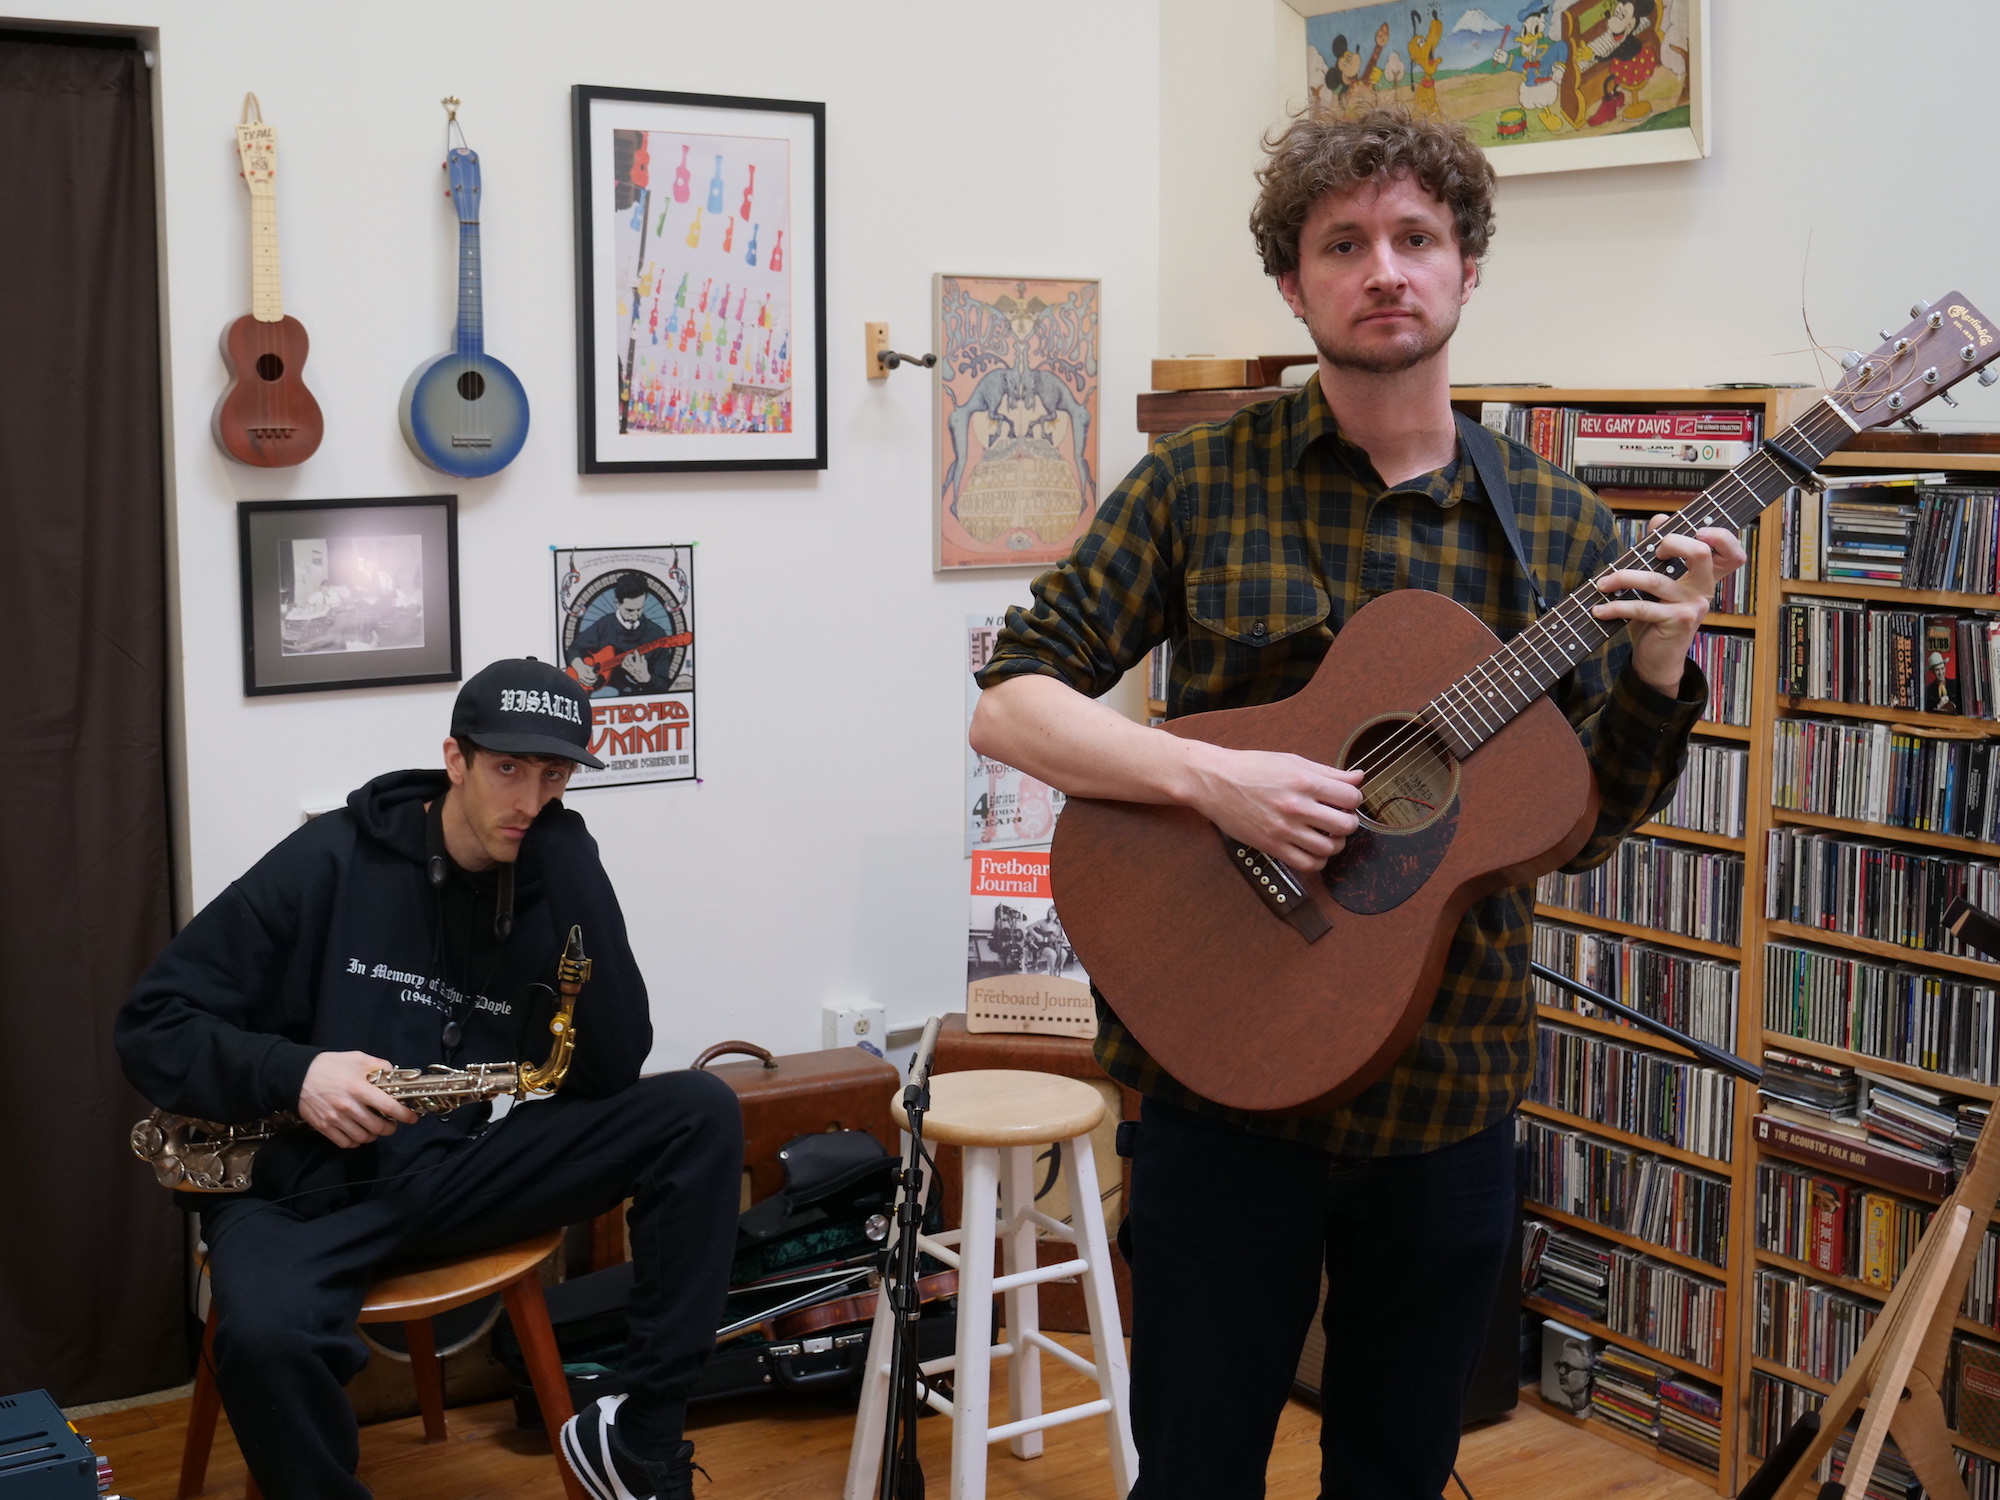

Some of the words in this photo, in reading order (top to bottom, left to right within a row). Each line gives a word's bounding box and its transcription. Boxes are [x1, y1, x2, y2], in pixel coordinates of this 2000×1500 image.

[1580, 418, 1602, 434] REV.
[1605, 418, 1635, 434] GARY
[1637, 418, 1671, 434] DAVIS
[1582, 468, 1618, 483] FRIENDS
[1620, 469, 1632, 484] OF
[1633, 469, 1650, 484] OLD
[1652, 470, 1674, 485] TIME
[1676, 470, 1705, 486] MUSIC
[972, 632, 980, 666] THE
[1929, 637, 1949, 650] TUBB
[1896, 636, 1907, 706] MONROE
[1904, 638, 1912, 678] BILL
[500, 689, 583, 726] VISALIA
[591, 701, 690, 725] ETBOARD
[587, 722, 690, 756] UMMIT
[972, 792, 989, 819] 4
[980, 858, 1050, 876] Fretboar
[976, 876, 1038, 894] Journal
[346, 958, 367, 976] In
[370, 963, 426, 989] Memory
[428, 978, 440, 992] of
[474, 994, 512, 1016] Doyle
[974, 988, 1040, 1006] Fretboard
[1042, 992, 1094, 1011] Journal
[1774, 1128, 1788, 1142] THE
[1789, 1132, 1828, 1154] ACOUSTIC
[1828, 1146, 1848, 1160] FOLK
[1850, 1153, 1866, 1166] BOX
[1820, 1224, 1832, 1241] JOE
[1819, 1242, 1831, 1270] TURNER
